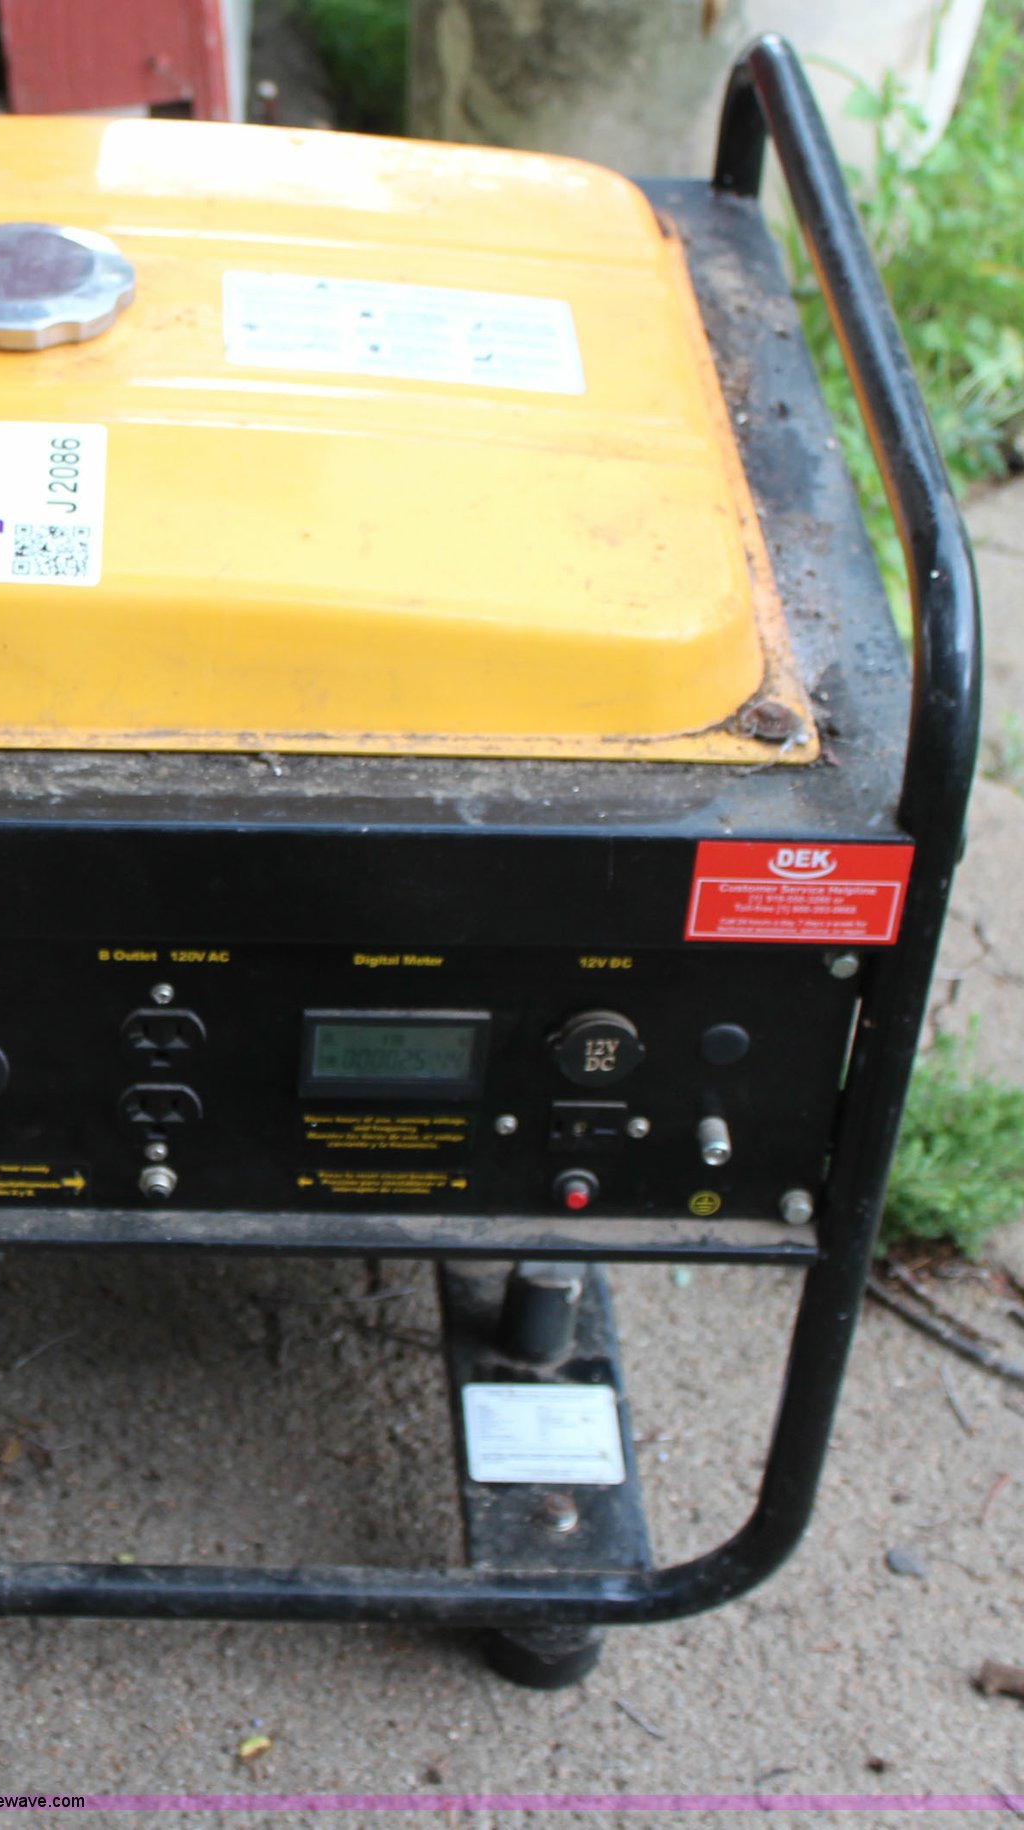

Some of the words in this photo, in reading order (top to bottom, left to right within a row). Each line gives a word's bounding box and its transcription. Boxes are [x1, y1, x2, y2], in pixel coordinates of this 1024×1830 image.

[48, 437, 81, 495] 2086
[47, 499, 78, 514] J
[777, 848, 832, 869] DEK
[97, 949, 110, 961] B
[113, 950, 159, 962] Outlet
[170, 950, 206, 963] 120V
[207, 951, 230, 963] AC
[352, 953, 400, 968] Digital
[401, 954, 444, 967] Meter
[579, 956, 607, 969] 12V
[609, 956, 633, 969] DC
[584, 1039, 620, 1056] 12V
[583, 1056, 616, 1072] DC
